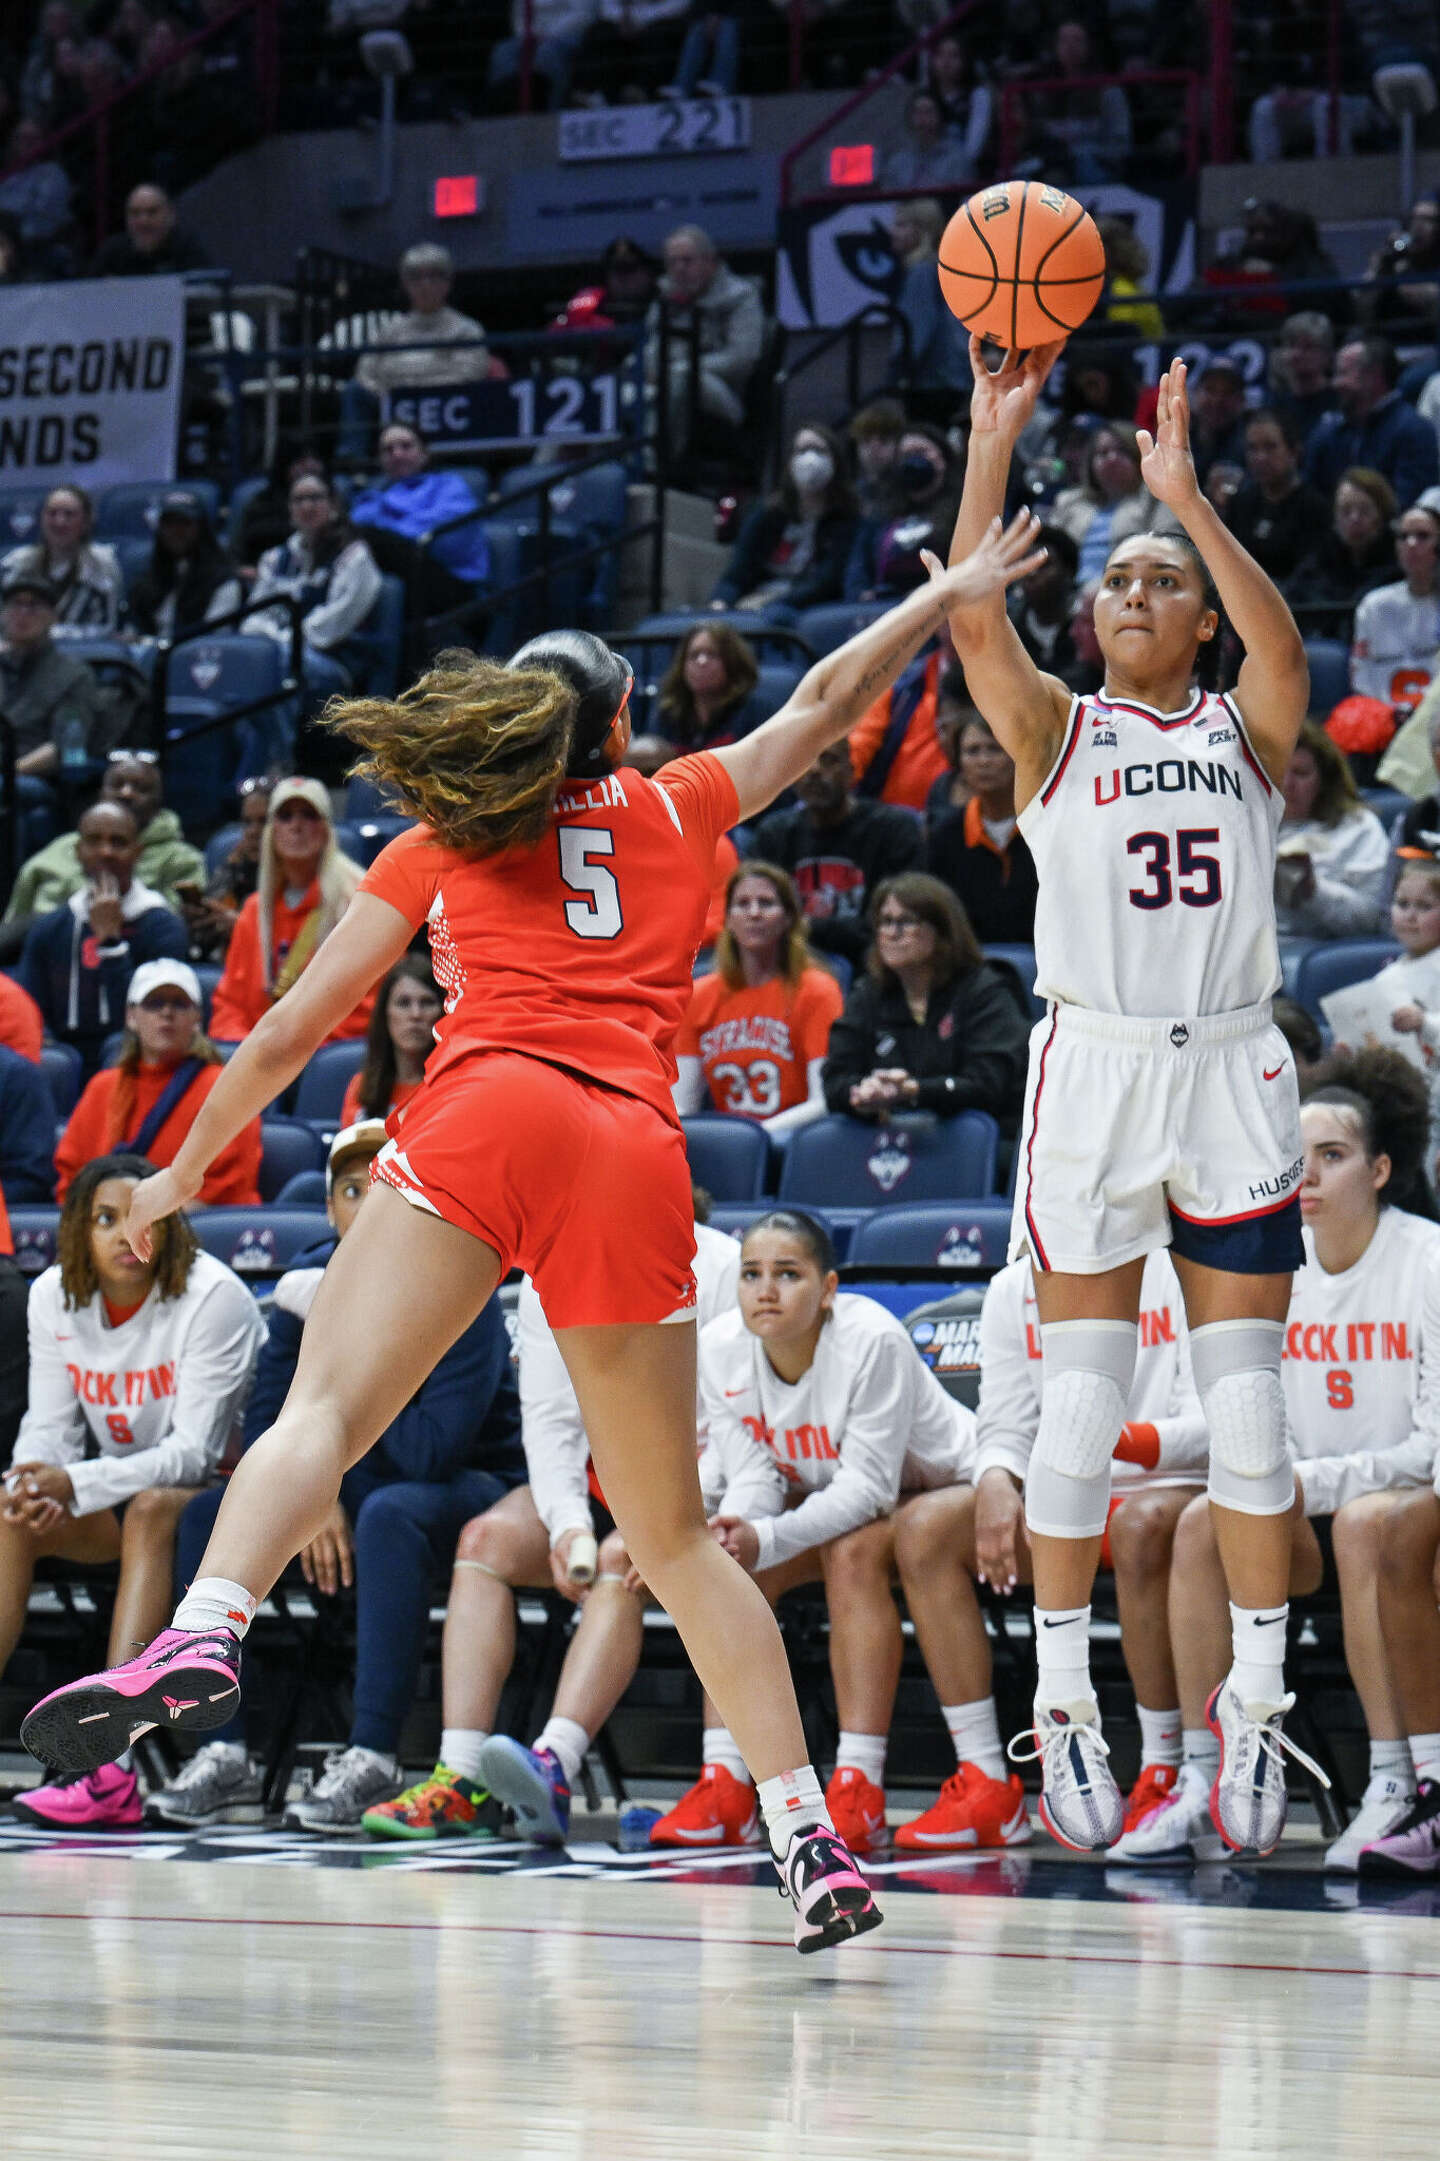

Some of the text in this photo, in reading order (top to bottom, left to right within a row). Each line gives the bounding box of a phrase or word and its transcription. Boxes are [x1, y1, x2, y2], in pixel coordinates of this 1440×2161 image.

[564, 101, 744, 151] SEC 221
[0, 337, 173, 398] SECOND
[394, 375, 618, 437] SEC 121
[1095, 760, 1243, 806] UCONN
[558, 825, 624, 940] 5
[1127, 828, 1223, 911] 35
[713, 1060, 780, 1115] 33
[1346, 1322, 1376, 1362] IT
[1326, 1369, 1354, 1409] S
